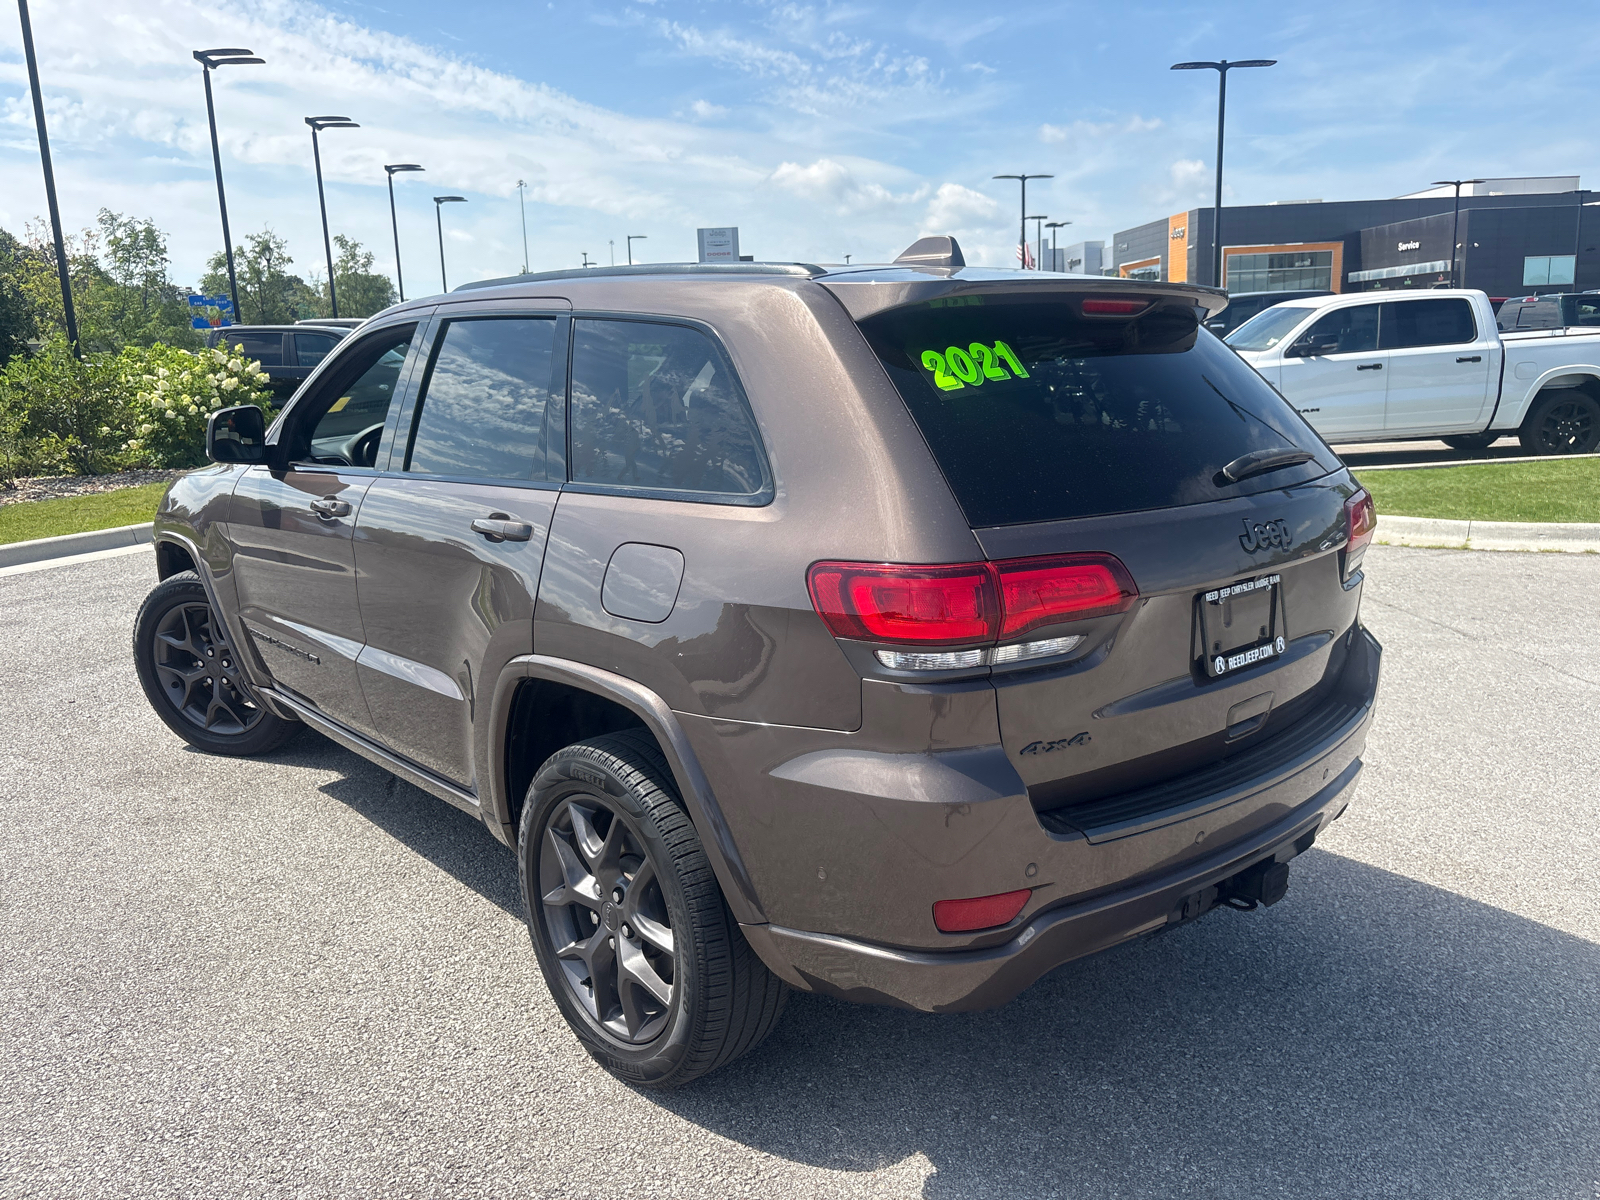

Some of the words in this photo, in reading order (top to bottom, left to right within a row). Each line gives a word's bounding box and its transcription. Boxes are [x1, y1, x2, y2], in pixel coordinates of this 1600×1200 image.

[1397, 240, 1420, 252] Service
[920, 340, 1030, 391] 2021
[1239, 517, 1293, 555] Jeep
[1205, 590, 1219, 602] REED
[1219, 587, 1231, 599] JEEP
[1231, 581, 1254, 595] CHRYSLER
[1254, 577, 1269, 590] DODGE
[1269, 574, 1280, 586] RAM
[1228, 644, 1273, 669] REEDJEEP.COM
[570, 762, 606, 790] PIRELLI
